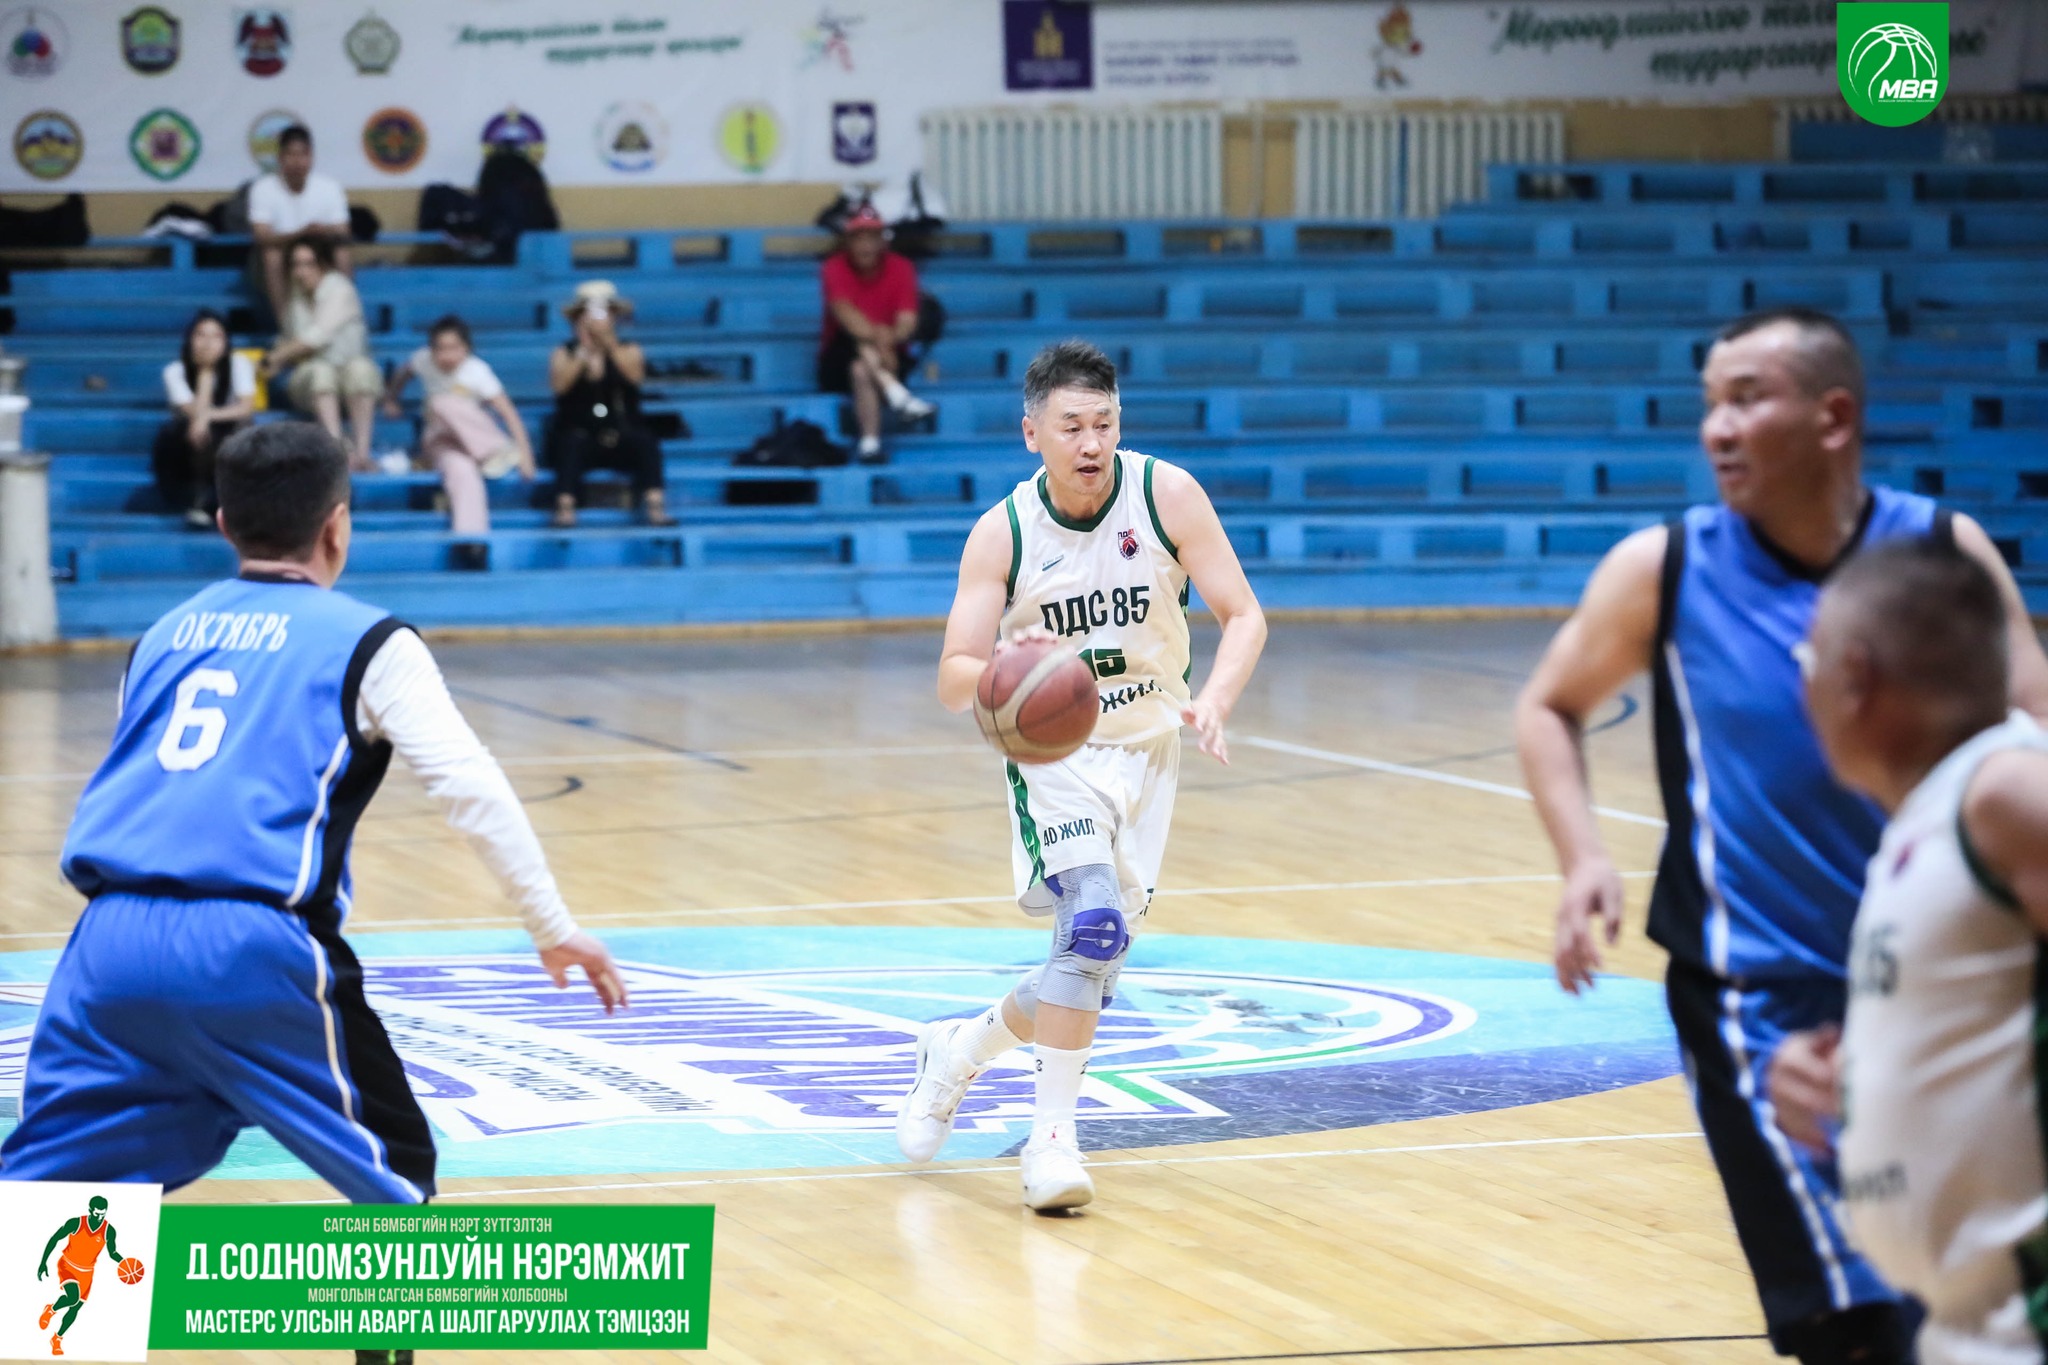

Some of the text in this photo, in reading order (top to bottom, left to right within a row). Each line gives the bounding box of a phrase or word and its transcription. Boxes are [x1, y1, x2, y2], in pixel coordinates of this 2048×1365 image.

[1040, 585, 1150, 637] ПДС 85
[172, 611, 292, 653] ОКТЯБРЬ
[157, 667, 239, 772] 6
[1043, 818, 1096, 847] 40 ЖИЛ
[477, 1040, 606, 1067] САГСАН
[478, 1066, 603, 1102] ТЭМЦЭЭН
